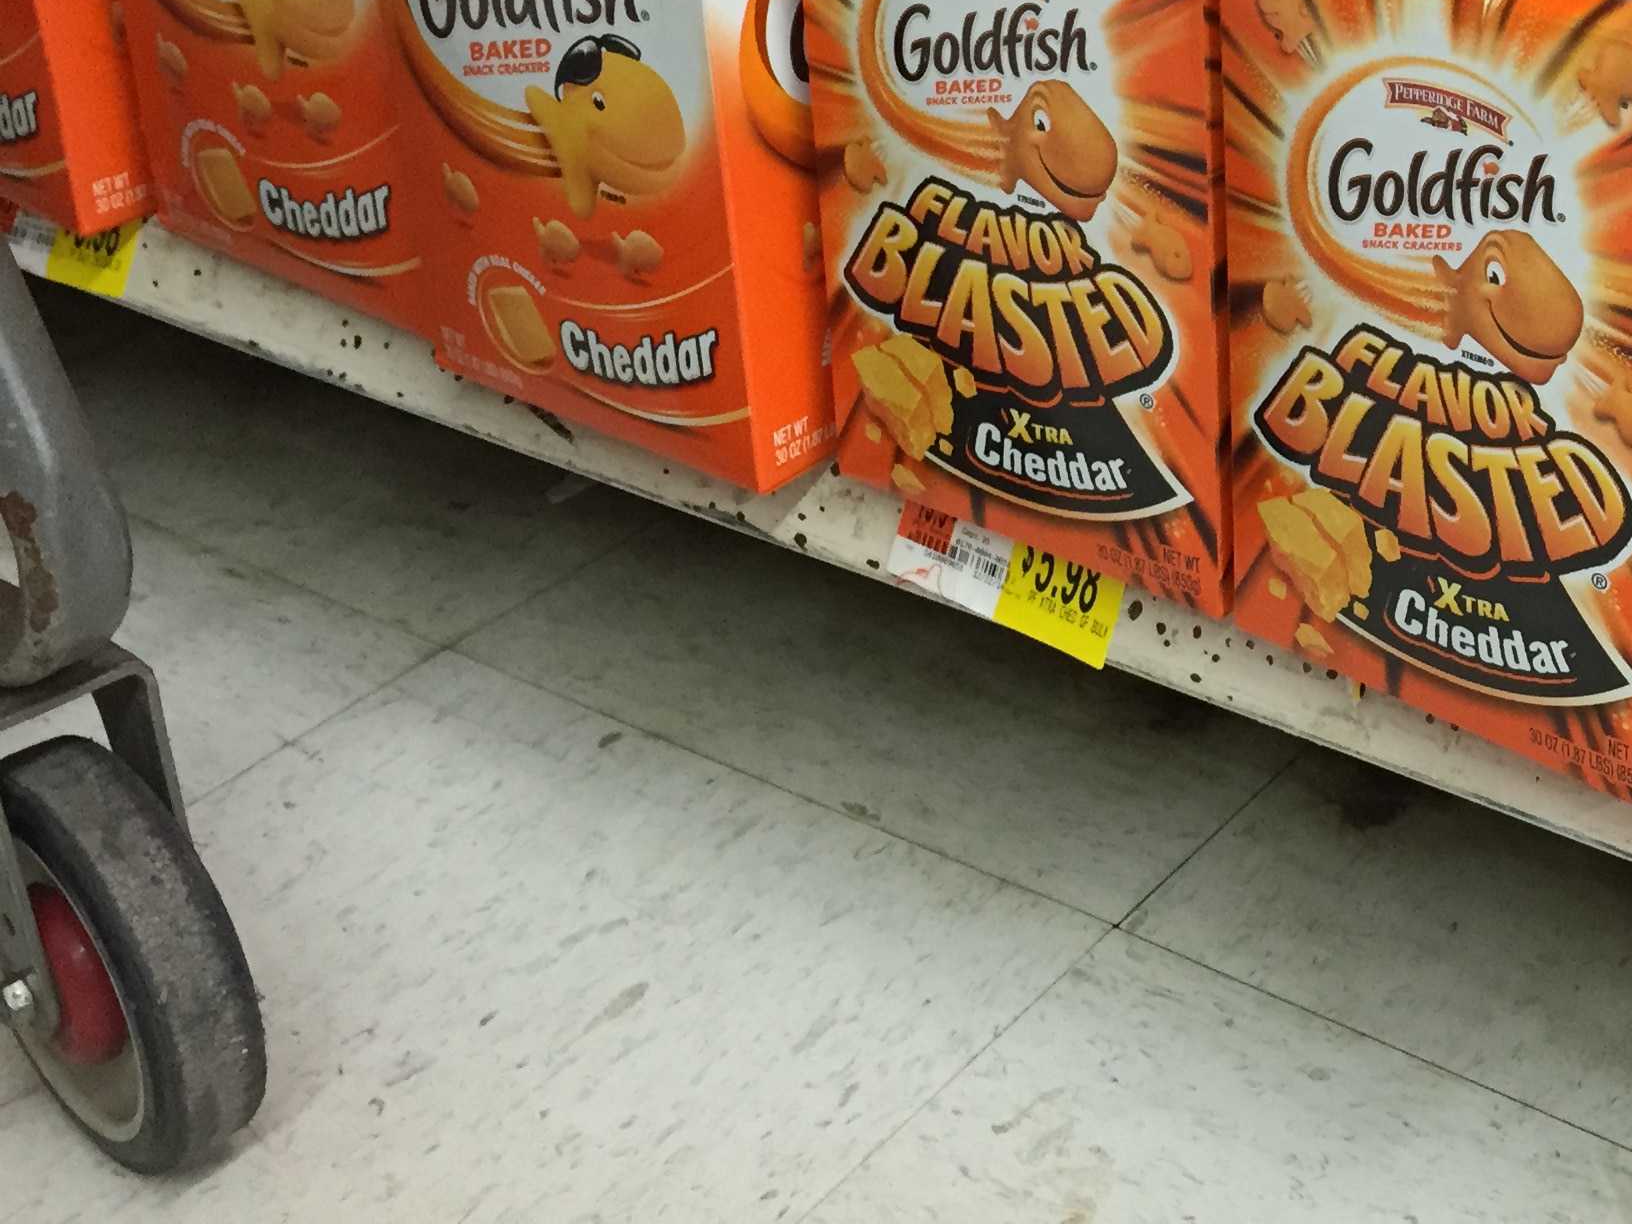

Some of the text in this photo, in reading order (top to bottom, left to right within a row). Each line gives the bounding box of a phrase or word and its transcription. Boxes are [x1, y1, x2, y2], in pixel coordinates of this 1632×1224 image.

[469, 38, 552, 61] BAKED
[935, 79, 1002, 95] BAKED
[1395, 81, 1501, 129] PEPPERIDGE FARM
[258, 178, 391, 240] Cheddar
[909, 182, 1095, 275] FLAVOR
[1374, 223, 1452, 240] BAKED
[850, 206, 1166, 391] BLASTED
[559, 319, 718, 387] Cheddar
[1334, 330, 1550, 444] FLAVOR
[974, 421, 1127, 492] Cheddar
[1008, 409, 1073, 446] XTRA
[1261, 350, 1628, 566] BLASTED
[1433, 576, 1510, 623] XTRA
[1394, 588, 1572, 675] Cheddar
[1608, 739, 1629, 761] NET
